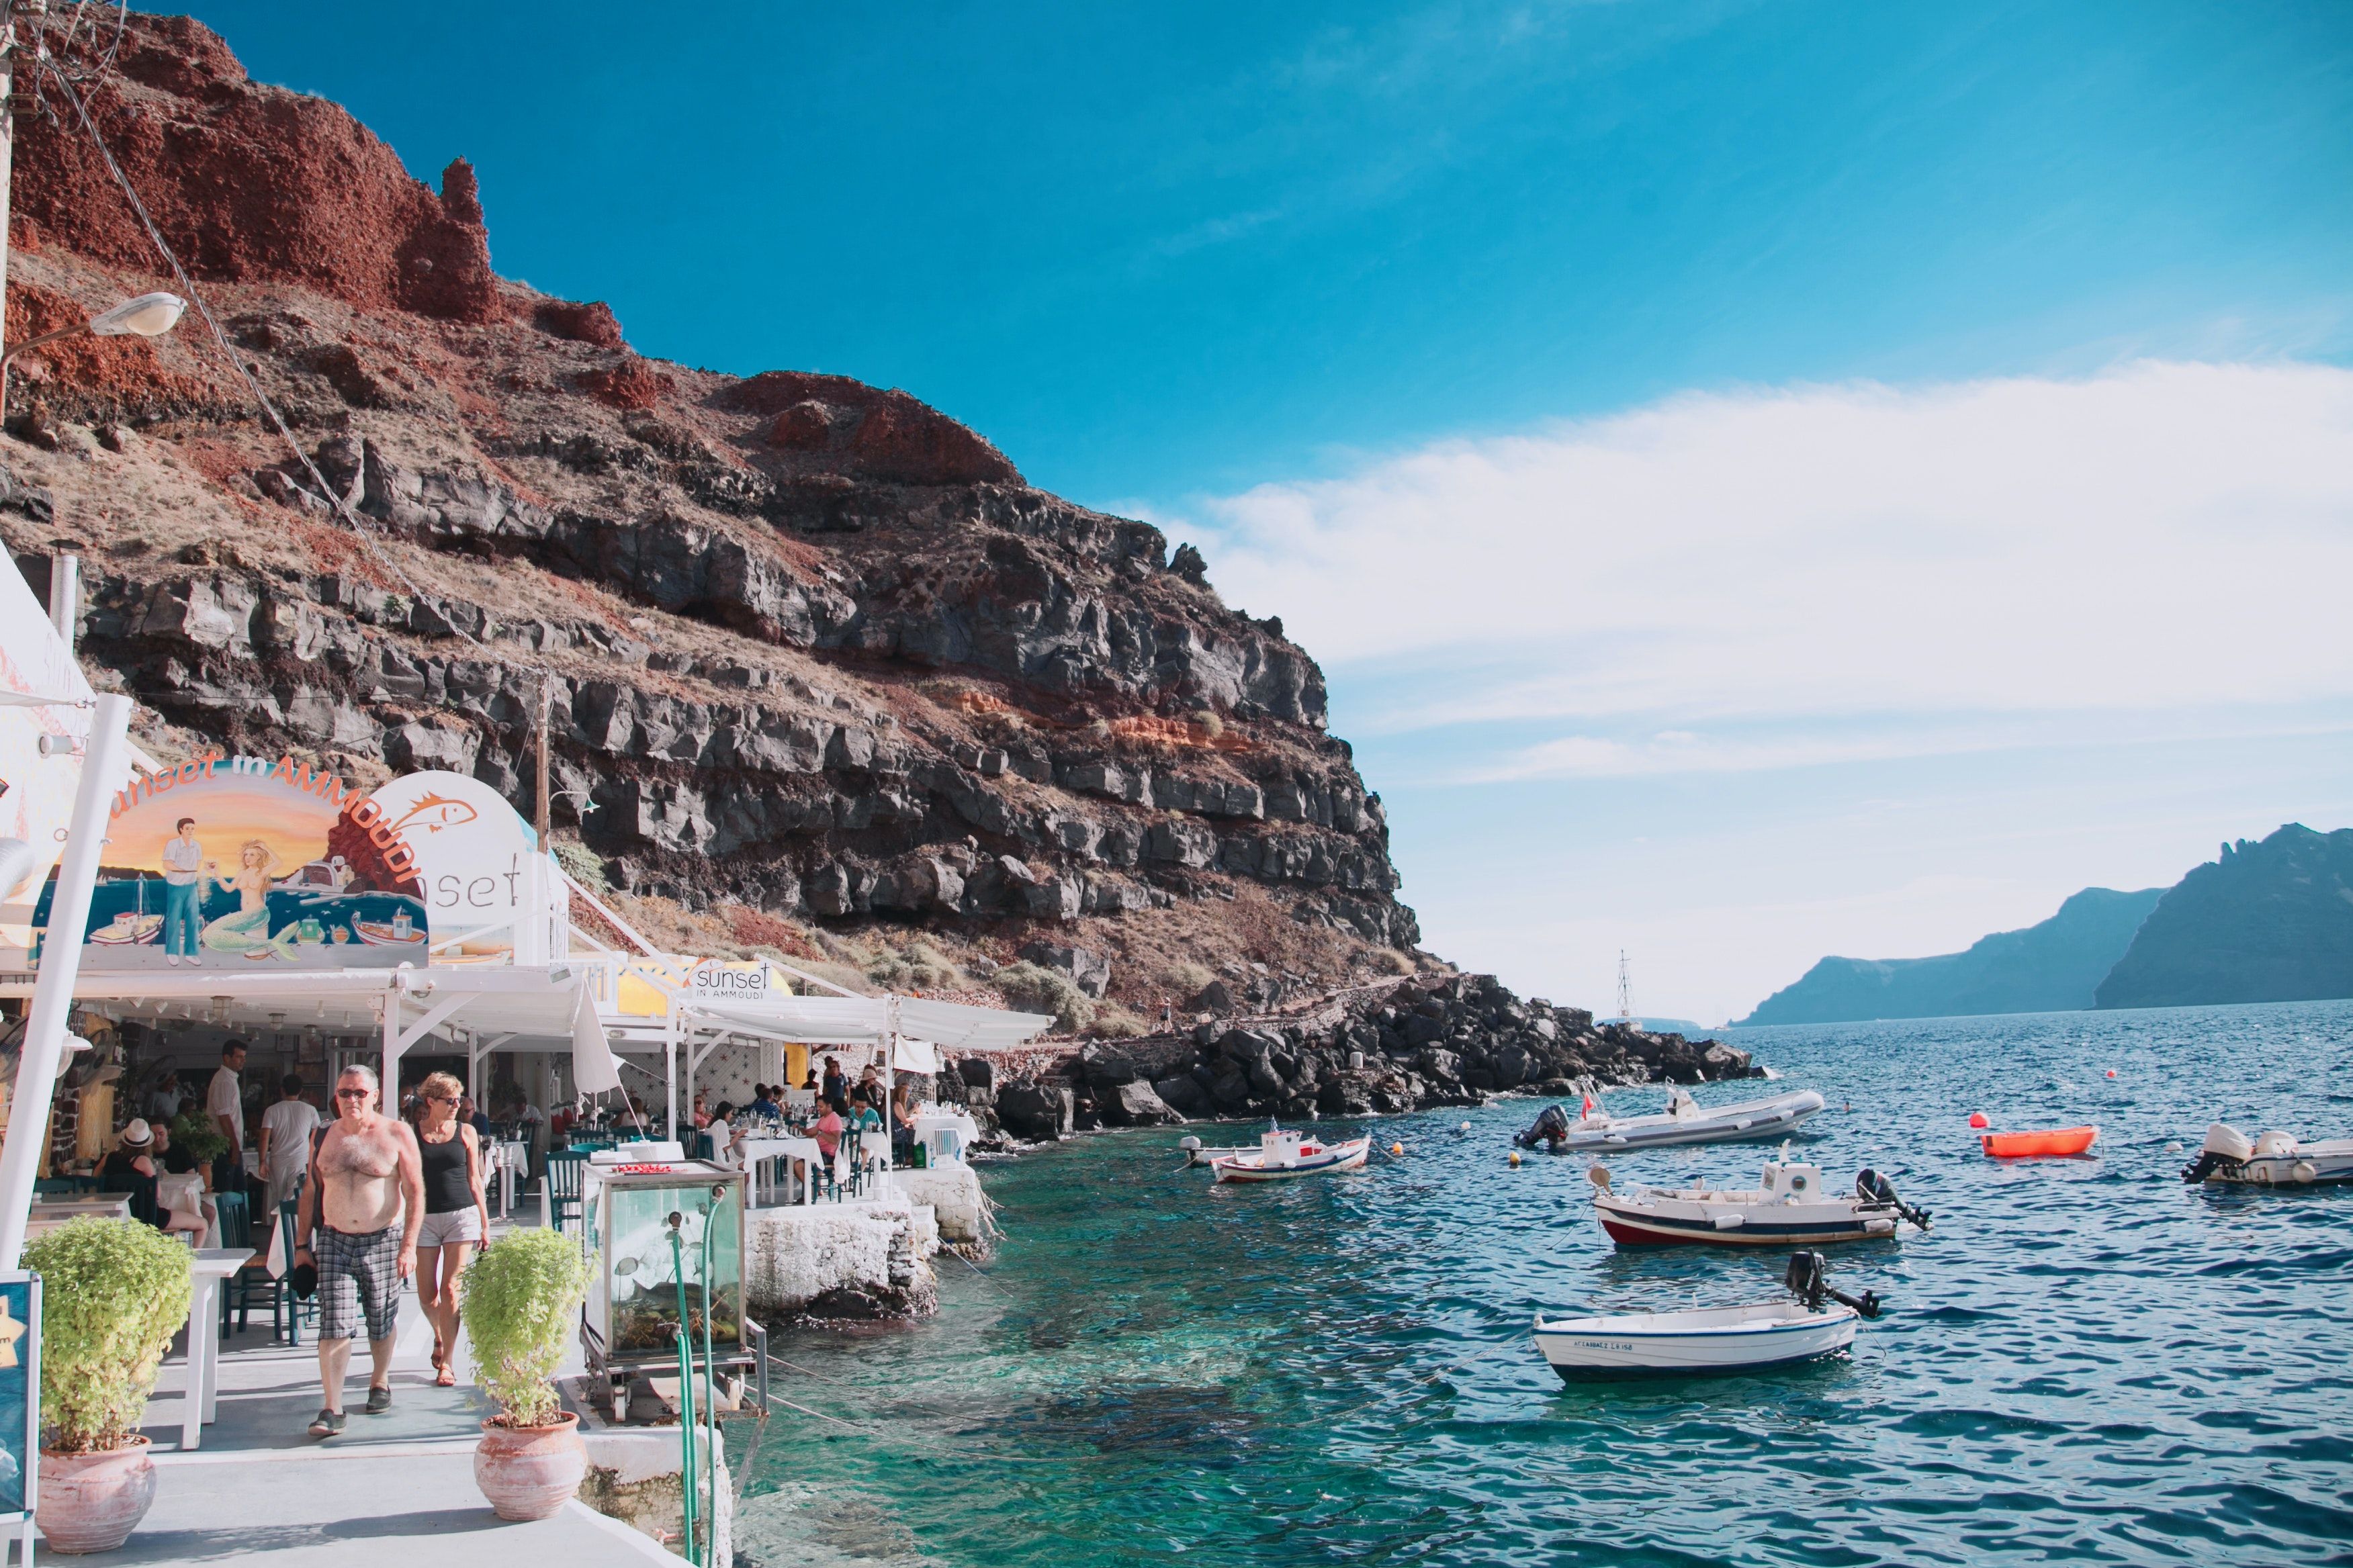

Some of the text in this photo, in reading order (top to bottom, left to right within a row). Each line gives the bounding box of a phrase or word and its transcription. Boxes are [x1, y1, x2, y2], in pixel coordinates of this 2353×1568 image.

[111, 750, 224, 819] unset
[271, 755, 422, 884] AMMOUDI
[697, 962, 770, 989] sunset
[696, 989, 763, 999] IN AMMOUDI
